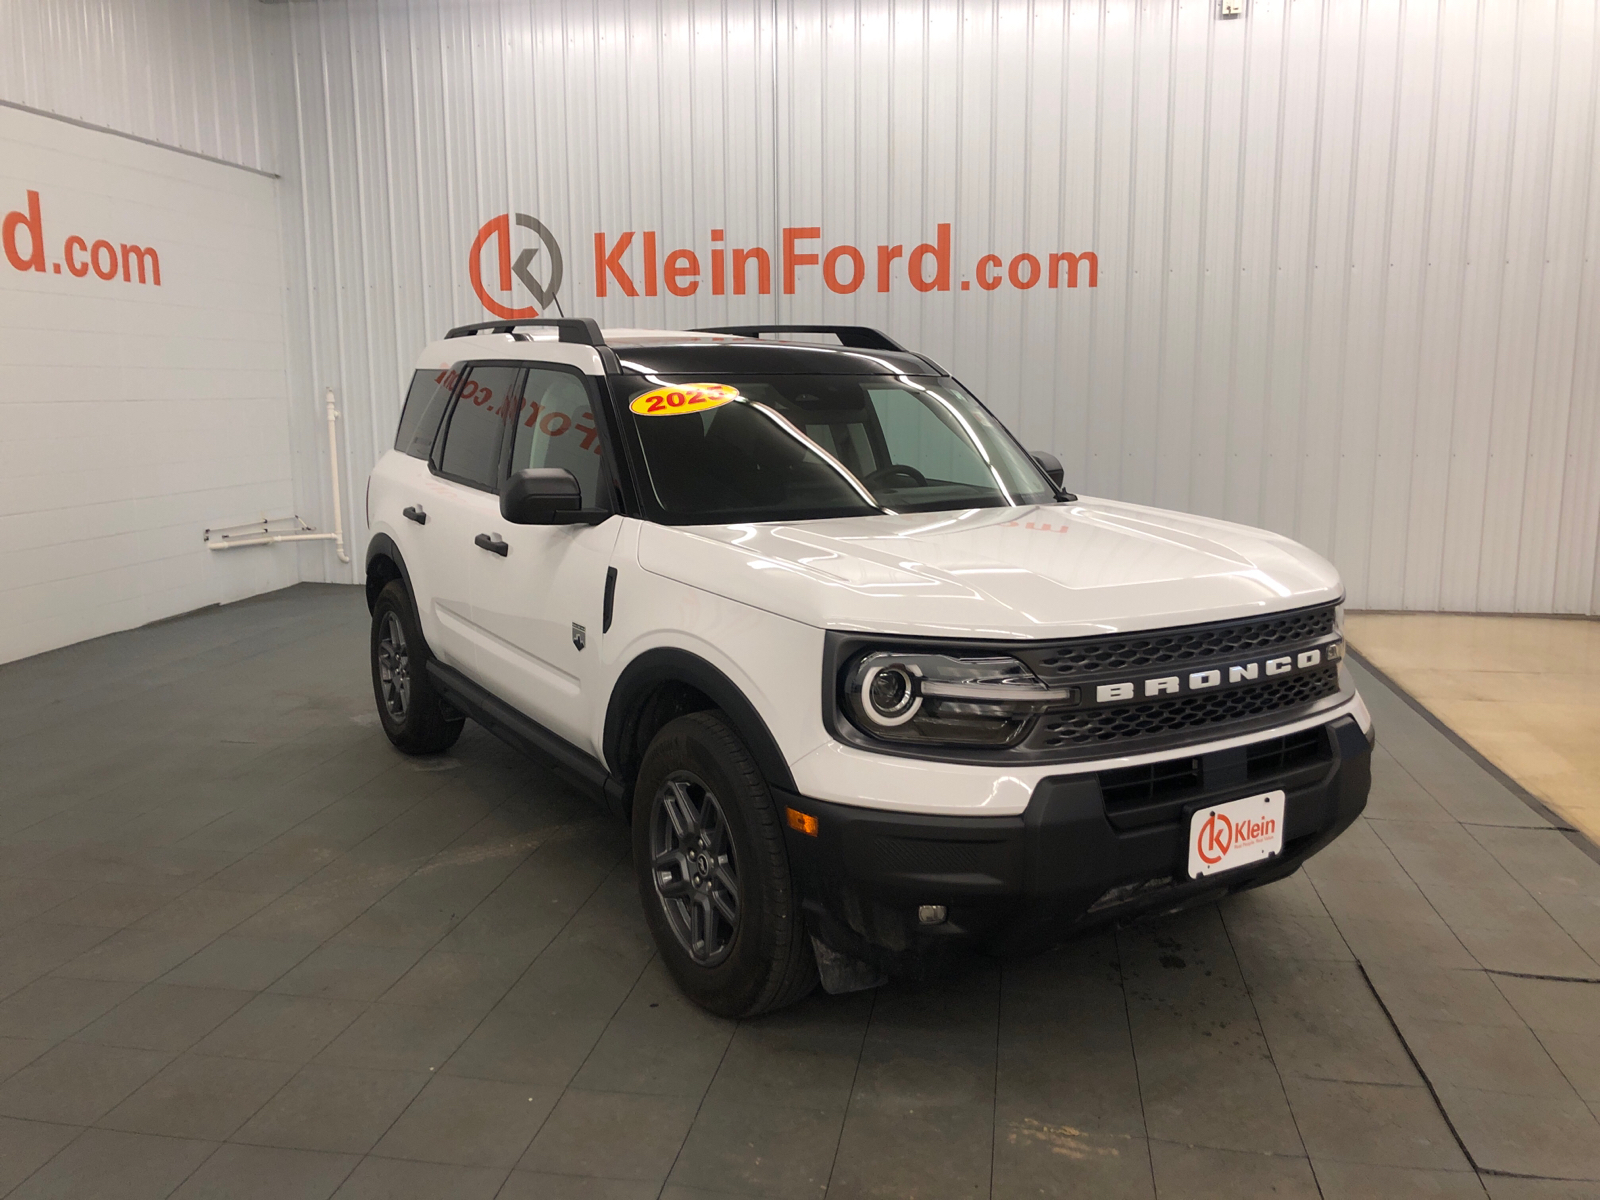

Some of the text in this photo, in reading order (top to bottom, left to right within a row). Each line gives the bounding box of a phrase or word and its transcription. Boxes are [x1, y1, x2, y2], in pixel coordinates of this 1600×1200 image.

[2, 189, 161, 286] d.com
[594, 223, 1099, 298] KleinFord.com
[1096, 649, 1321, 703] BRONCO
[1234, 815, 1276, 844] Klein
